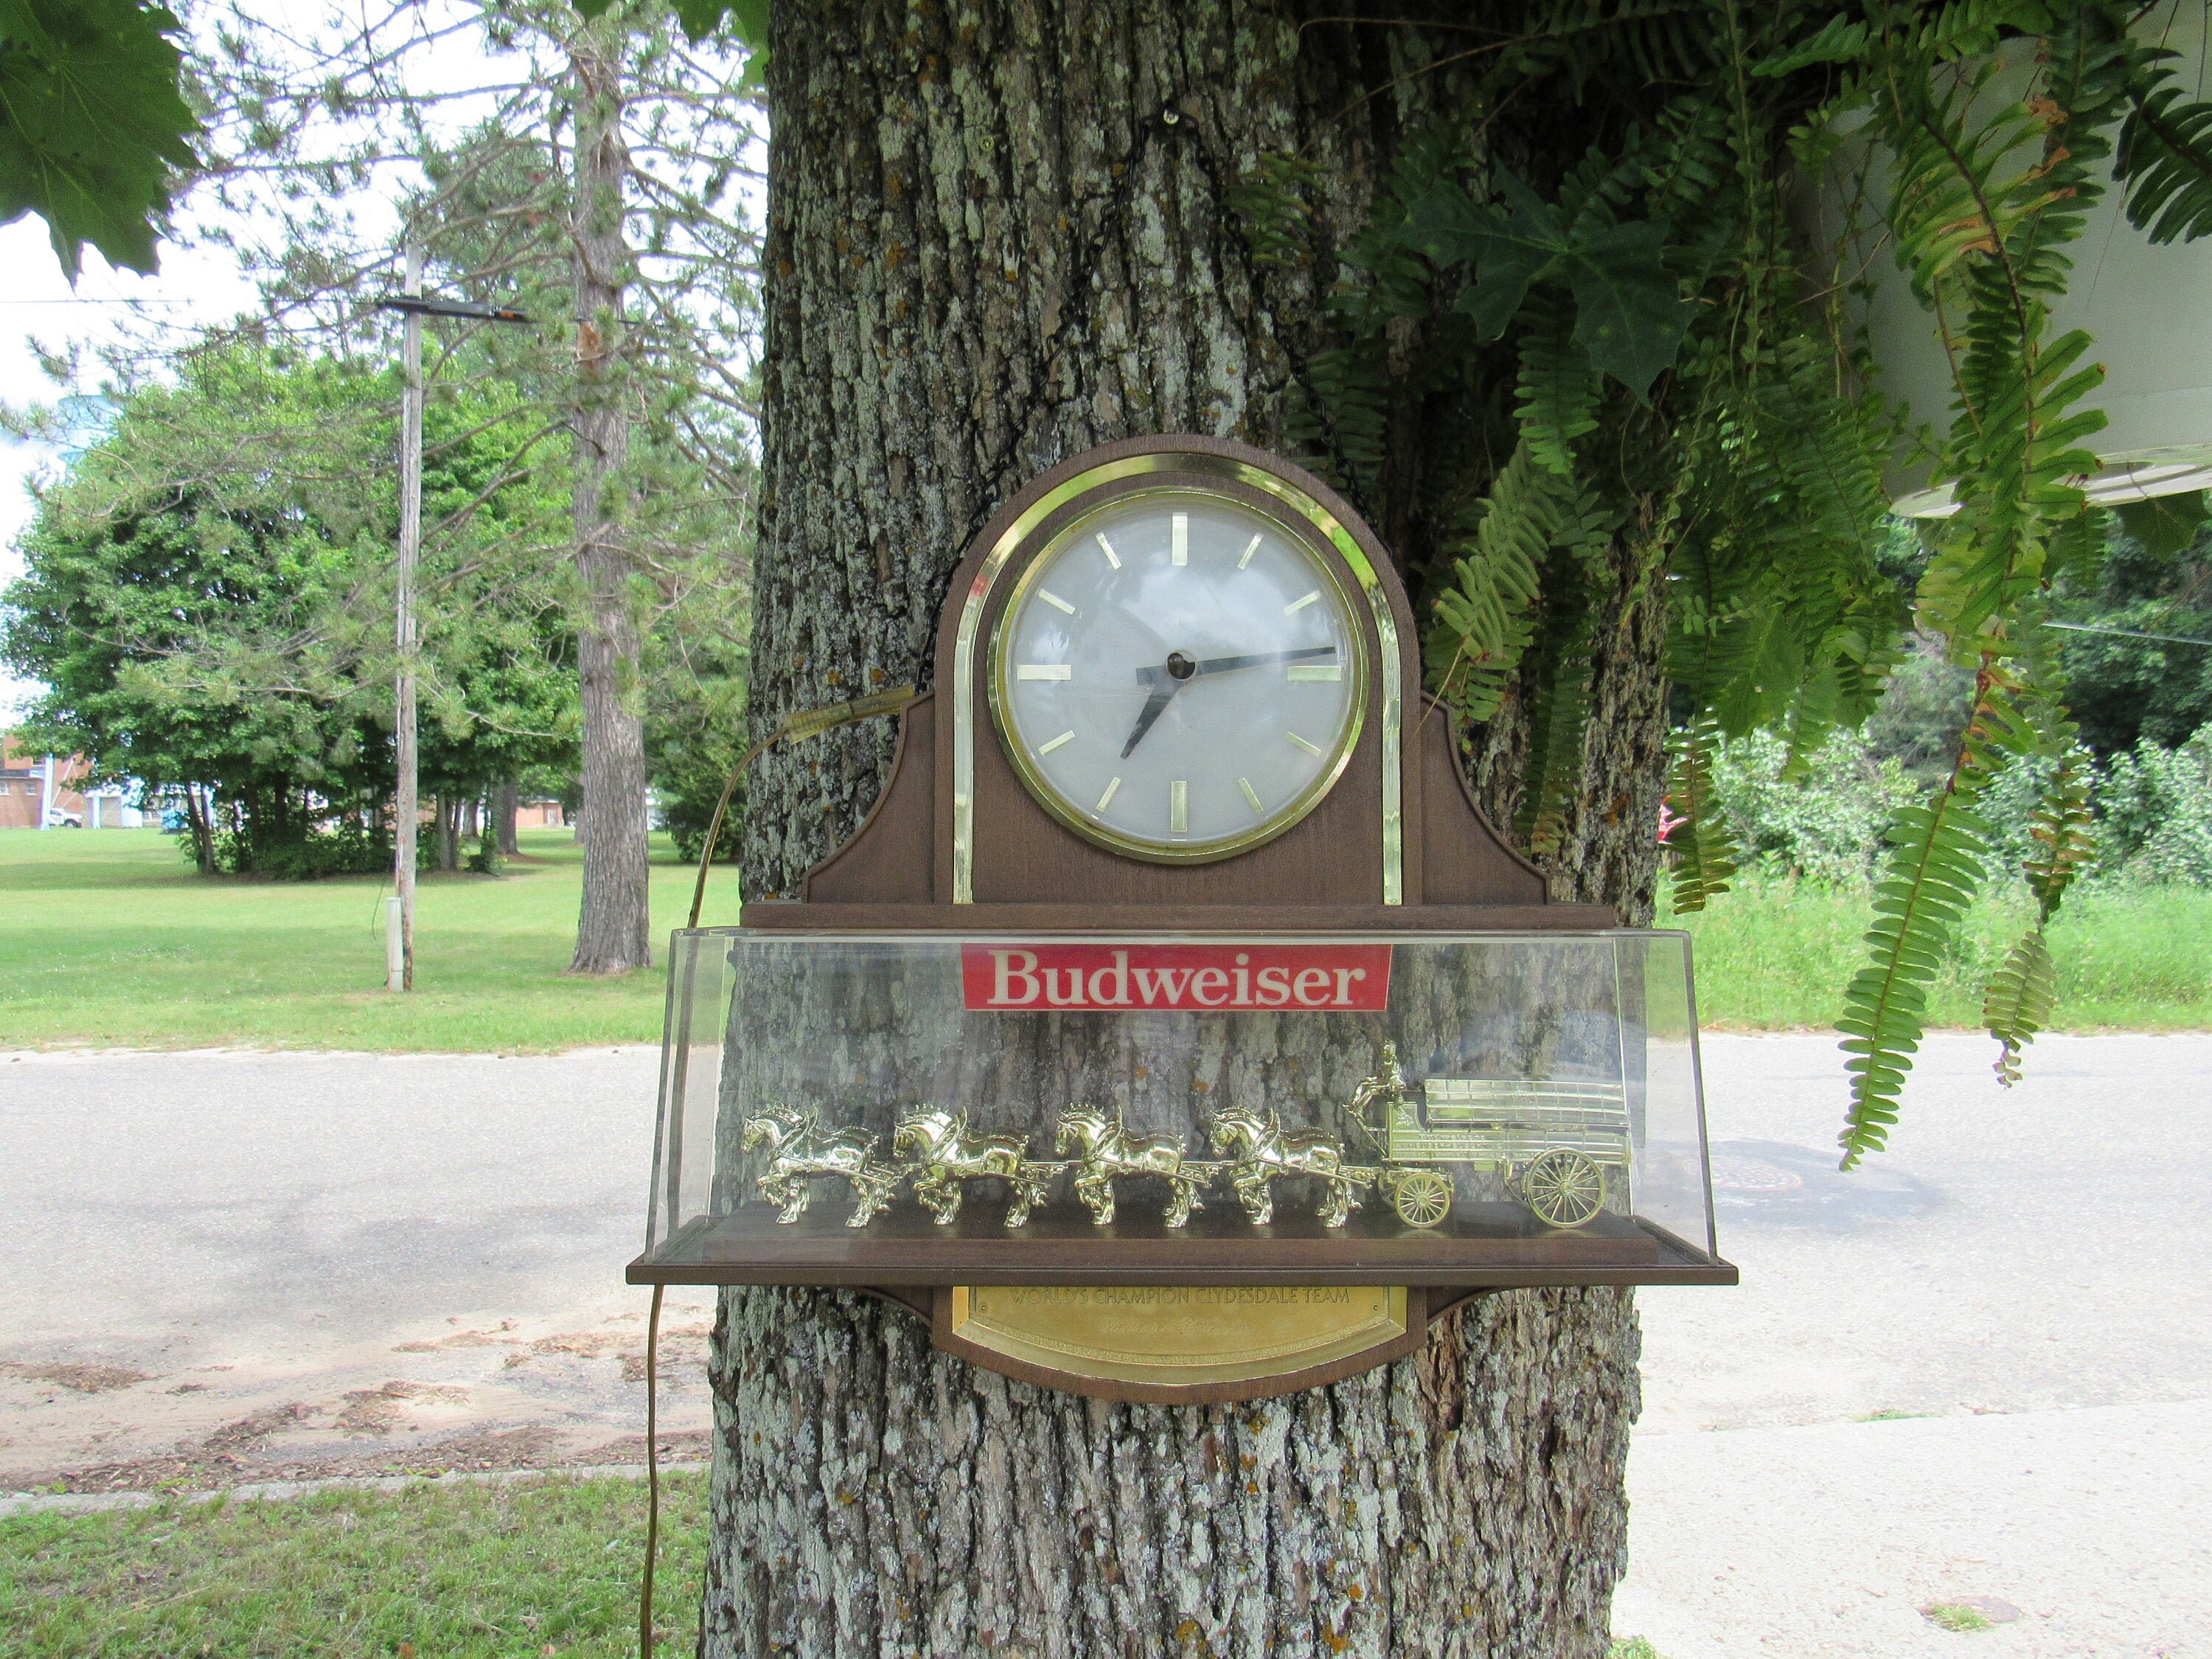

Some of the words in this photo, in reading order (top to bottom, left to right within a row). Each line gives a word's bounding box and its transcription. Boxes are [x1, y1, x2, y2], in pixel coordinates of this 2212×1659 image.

[987, 949, 1366, 1007] Budweiser
[1010, 1286, 1088, 1304] WORLD'S
[1093, 1286, 1189, 1304] CHAMPION
[1195, 1286, 1298, 1304] CLYDESDALE
[1303, 1286, 1351, 1304] TEAM
